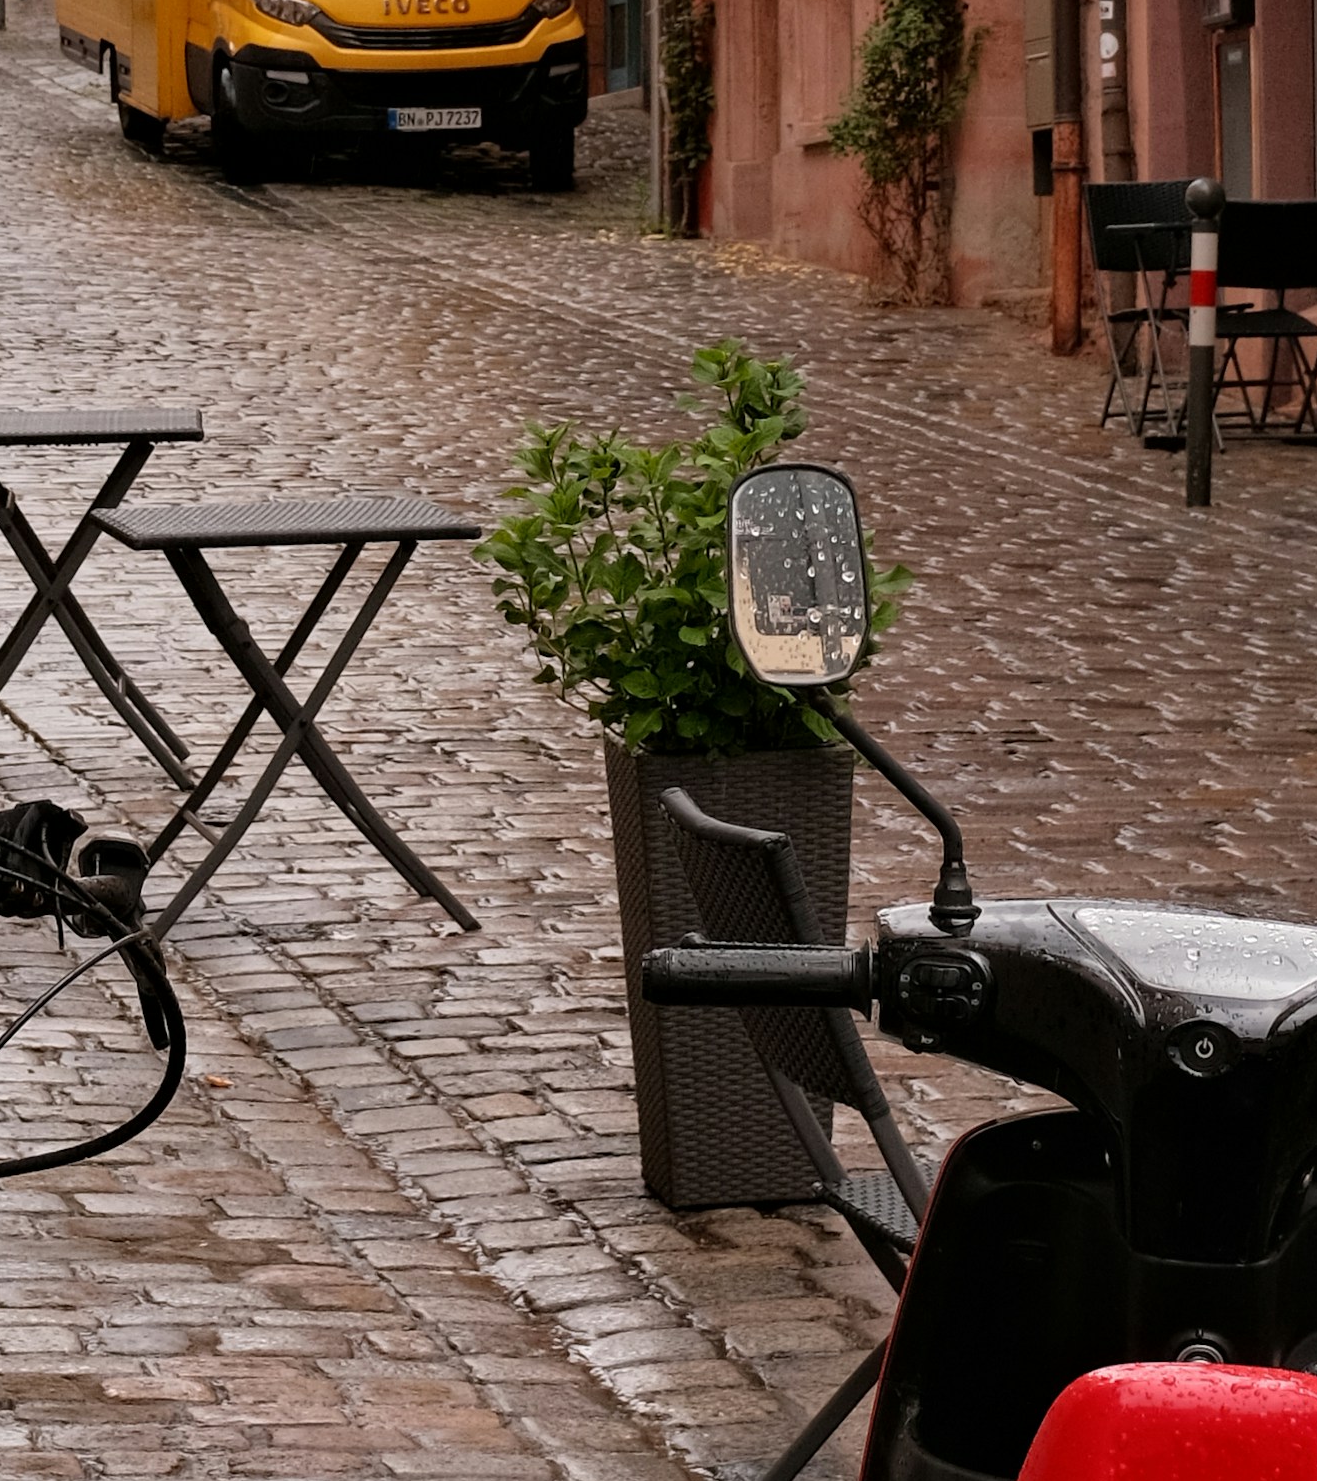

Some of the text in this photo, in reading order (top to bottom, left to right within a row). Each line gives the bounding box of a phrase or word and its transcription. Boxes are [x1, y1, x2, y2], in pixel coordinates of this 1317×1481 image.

[398, 110, 480, 127] BN PJ 7237
